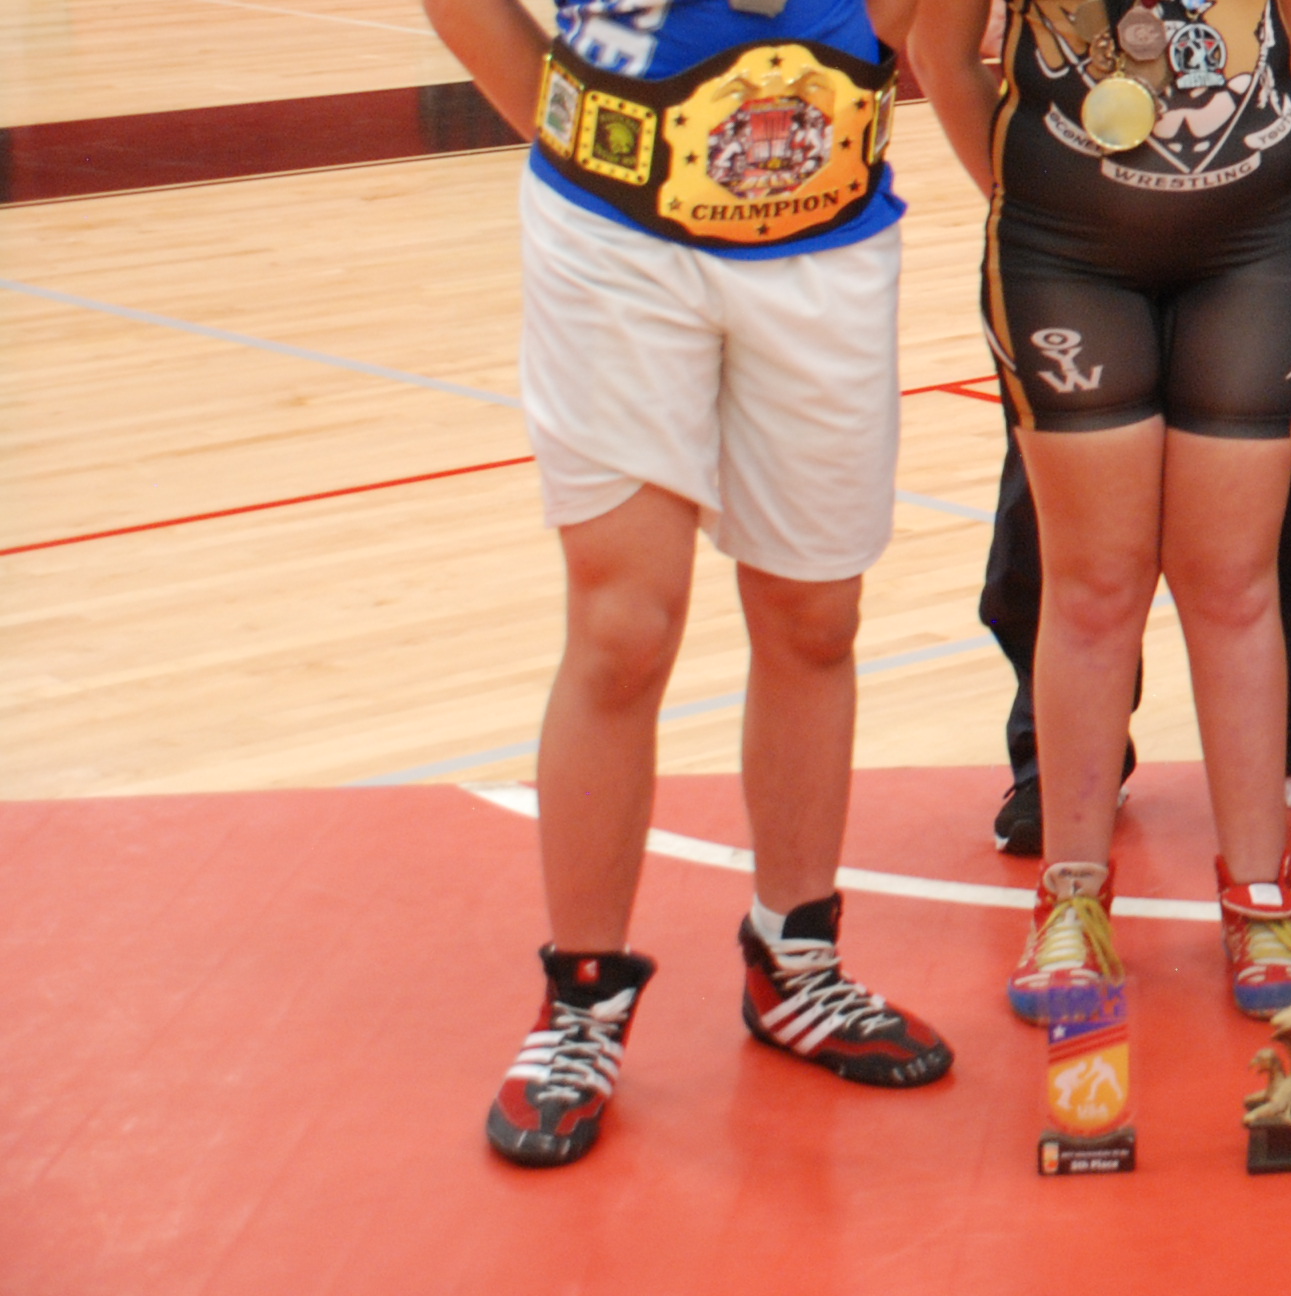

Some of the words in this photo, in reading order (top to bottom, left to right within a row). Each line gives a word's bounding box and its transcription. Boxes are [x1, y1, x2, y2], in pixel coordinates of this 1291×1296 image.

[1050, 109, 1099, 151] OCONE
[1114, 162, 1252, 189] WRESTLING
[690, 189, 840, 222] CHAMPION
